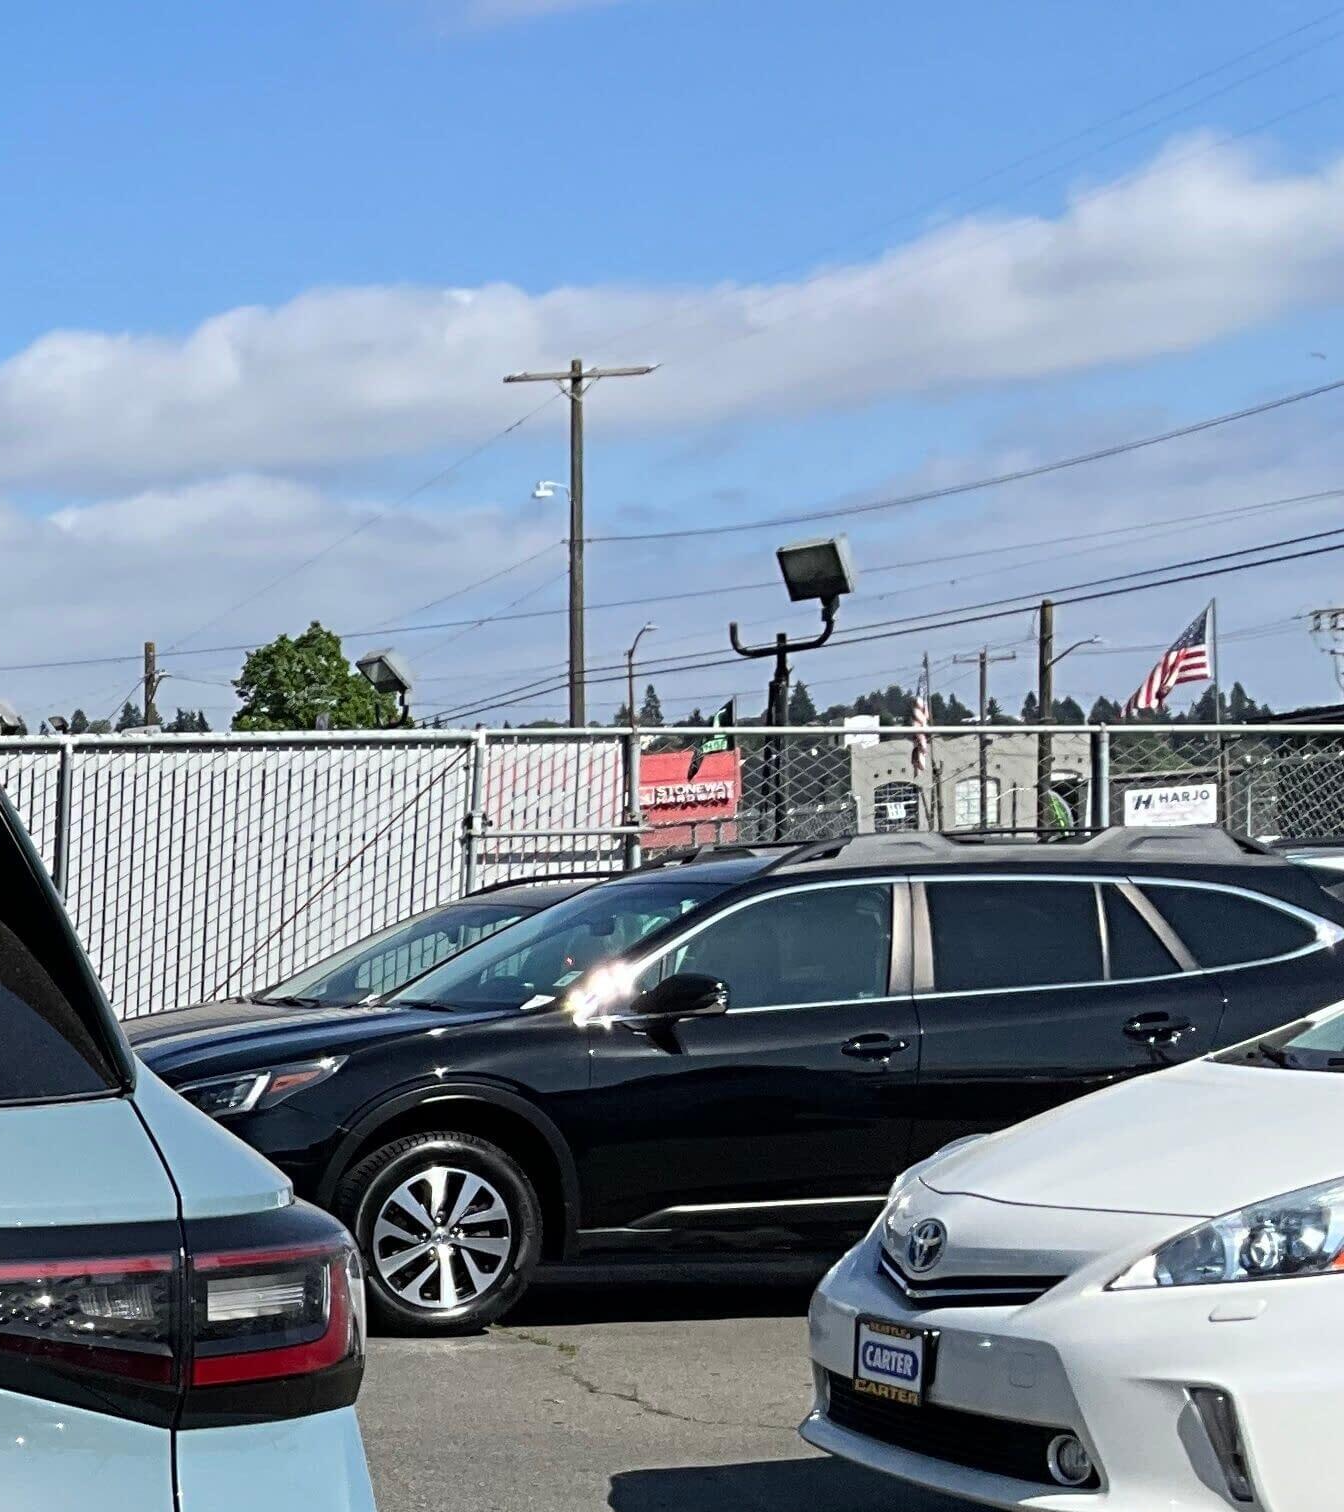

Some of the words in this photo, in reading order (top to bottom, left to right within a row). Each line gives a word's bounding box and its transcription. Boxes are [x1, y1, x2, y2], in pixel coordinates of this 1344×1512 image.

[654, 780, 735, 798] STONEWAY
[1159, 789, 1210, 803] HARJO
[865, 1345, 913, 1377] CARTER
[854, 1378, 919, 1405] CARTER
